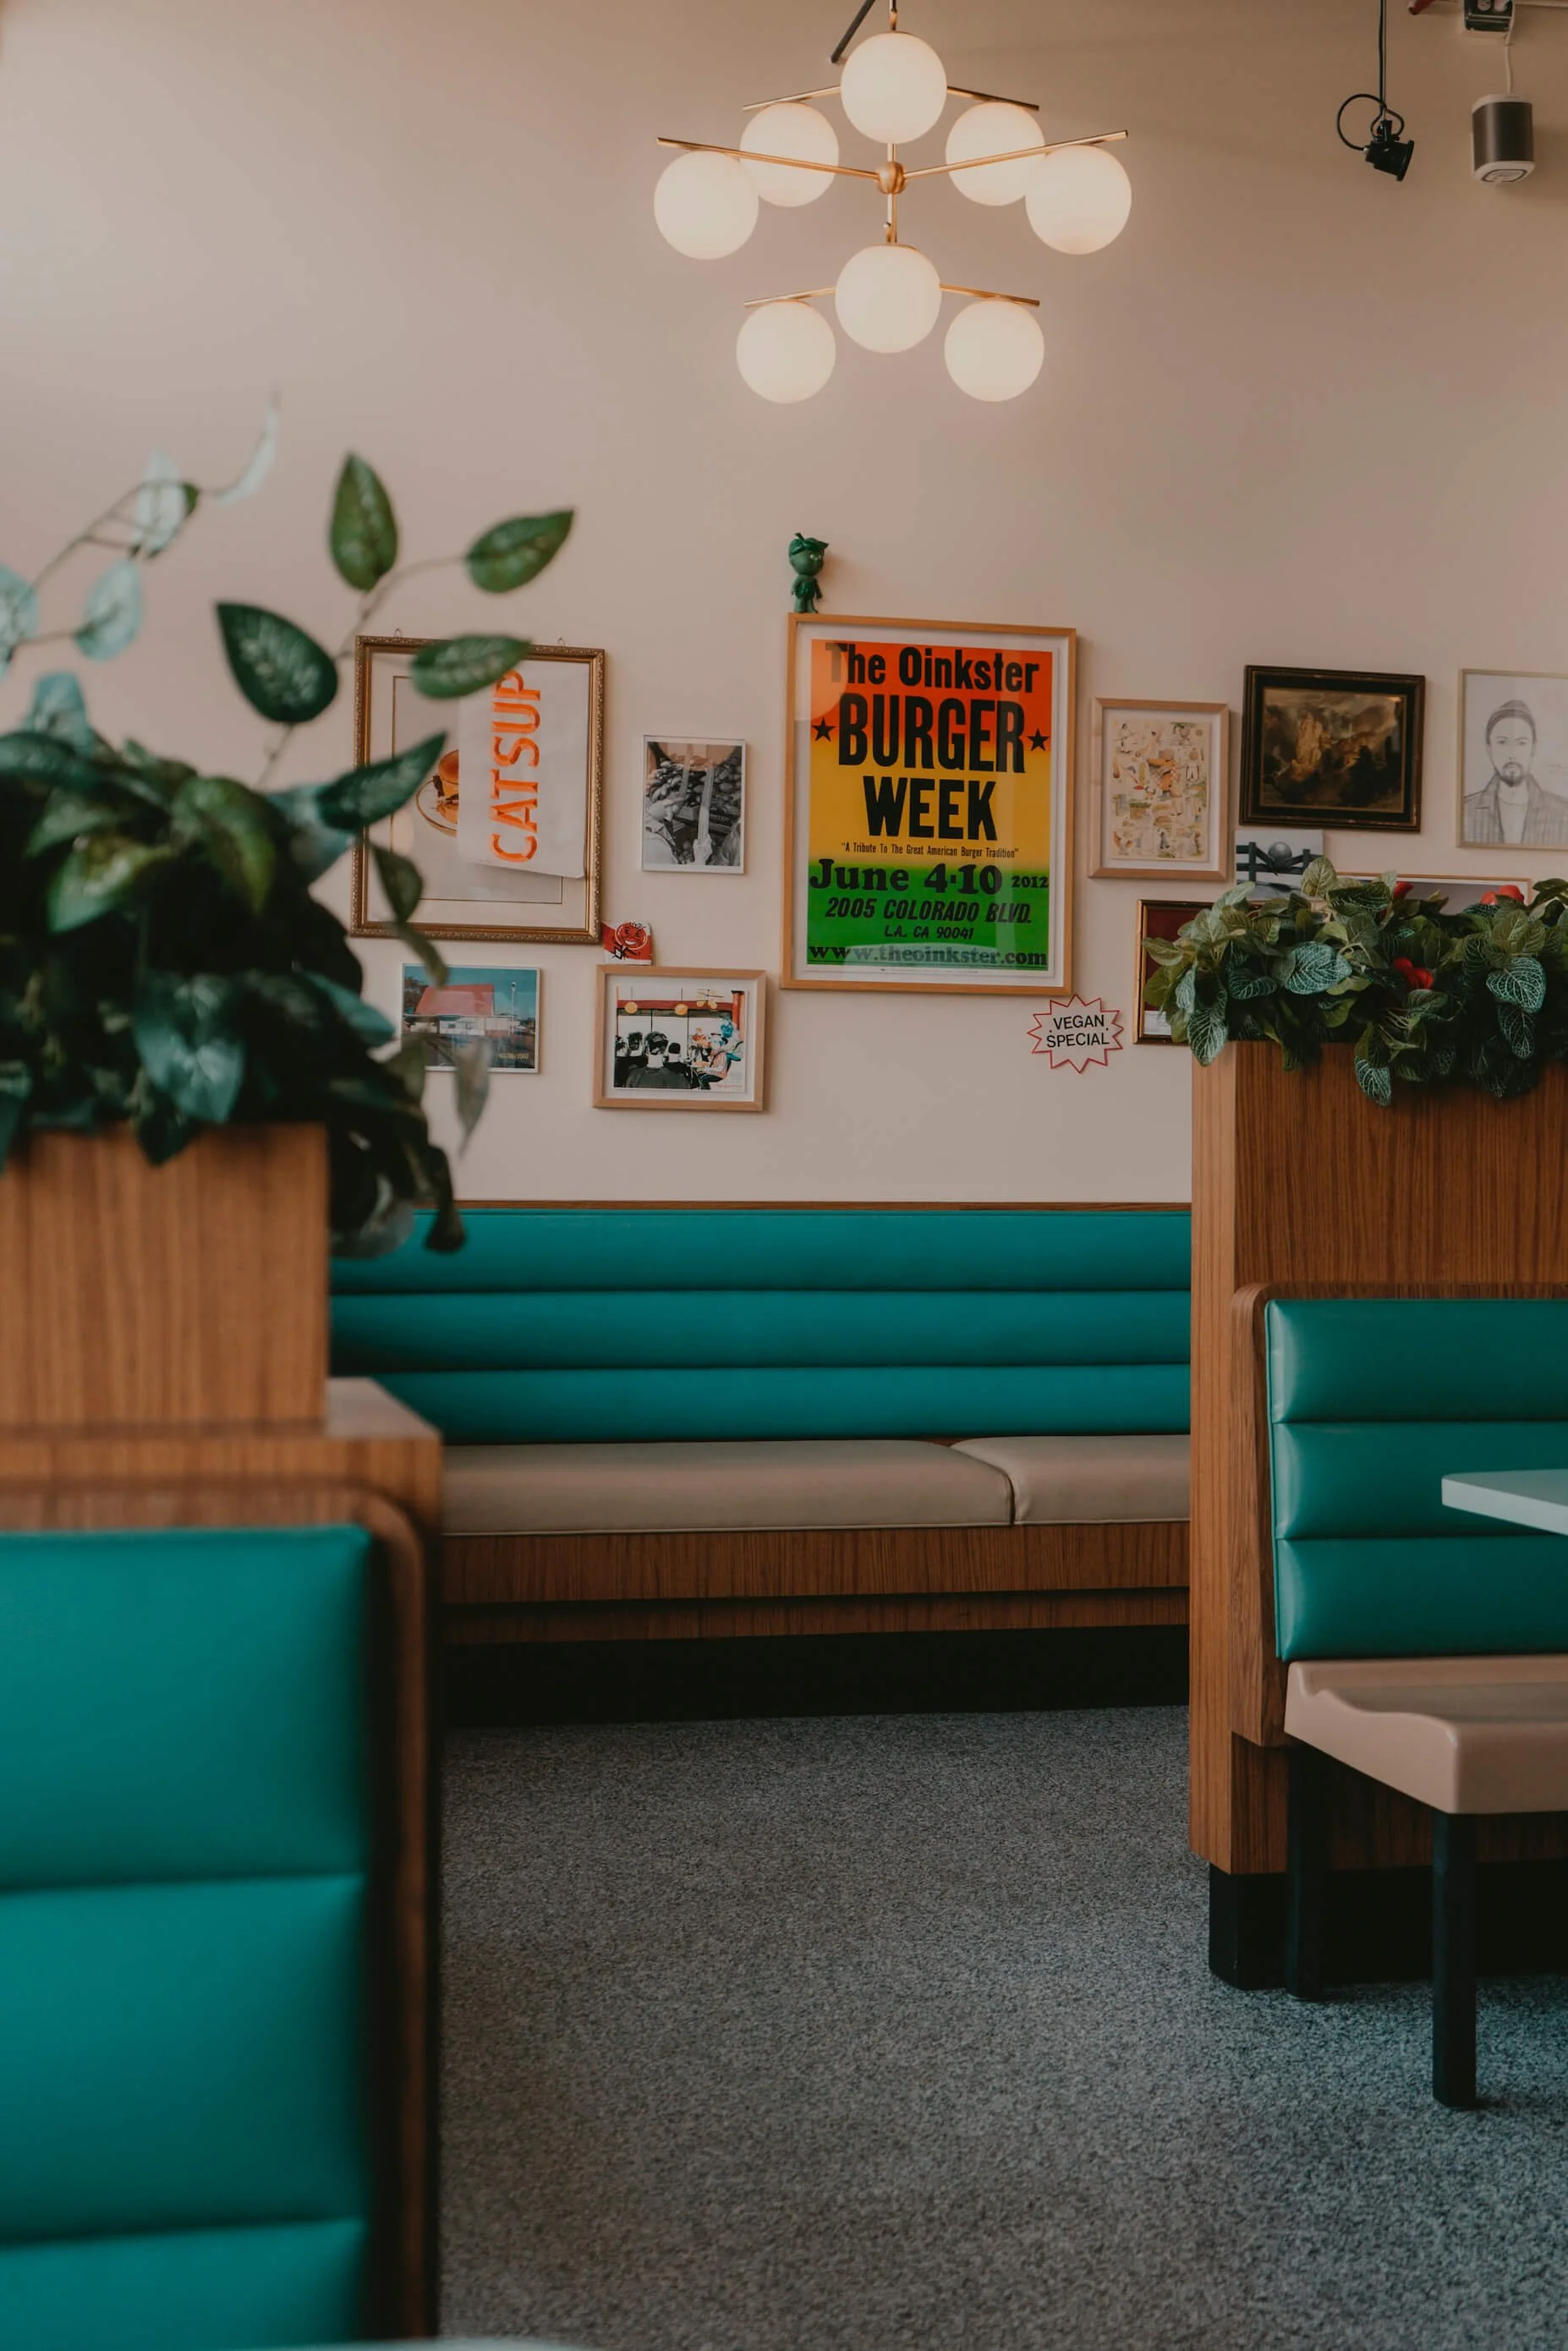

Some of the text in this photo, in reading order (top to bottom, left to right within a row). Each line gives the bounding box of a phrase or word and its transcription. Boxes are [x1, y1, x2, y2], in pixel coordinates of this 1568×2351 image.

[825, 643, 1039, 693] The Oinkster
[838, 692, 1025, 773] BURGER
[489, 669, 541, 863] CATSUP
[863, 775, 998, 841] WEEK
[853, 842, 876, 853] Tribute
[880, 843, 888, 853] To
[891, 844, 903, 854] The
[906, 845, 924, 855] Great
[927, 846, 958, 857] American
[961, 847, 983, 858] Burger
[809, 858, 910, 892] June
[1011, 874, 1049, 888] 2012
[825, 897, 1032, 923] 2005 COLORADO BLVD.
[913, 925, 929, 938] CA
[936, 927, 974, 940] 90041
[809, 945, 1047, 965] www.theoinkster.com
[1053, 1014, 1105, 1030] VEGAN
[1046, 1032, 1110, 1048] SPECIAL
